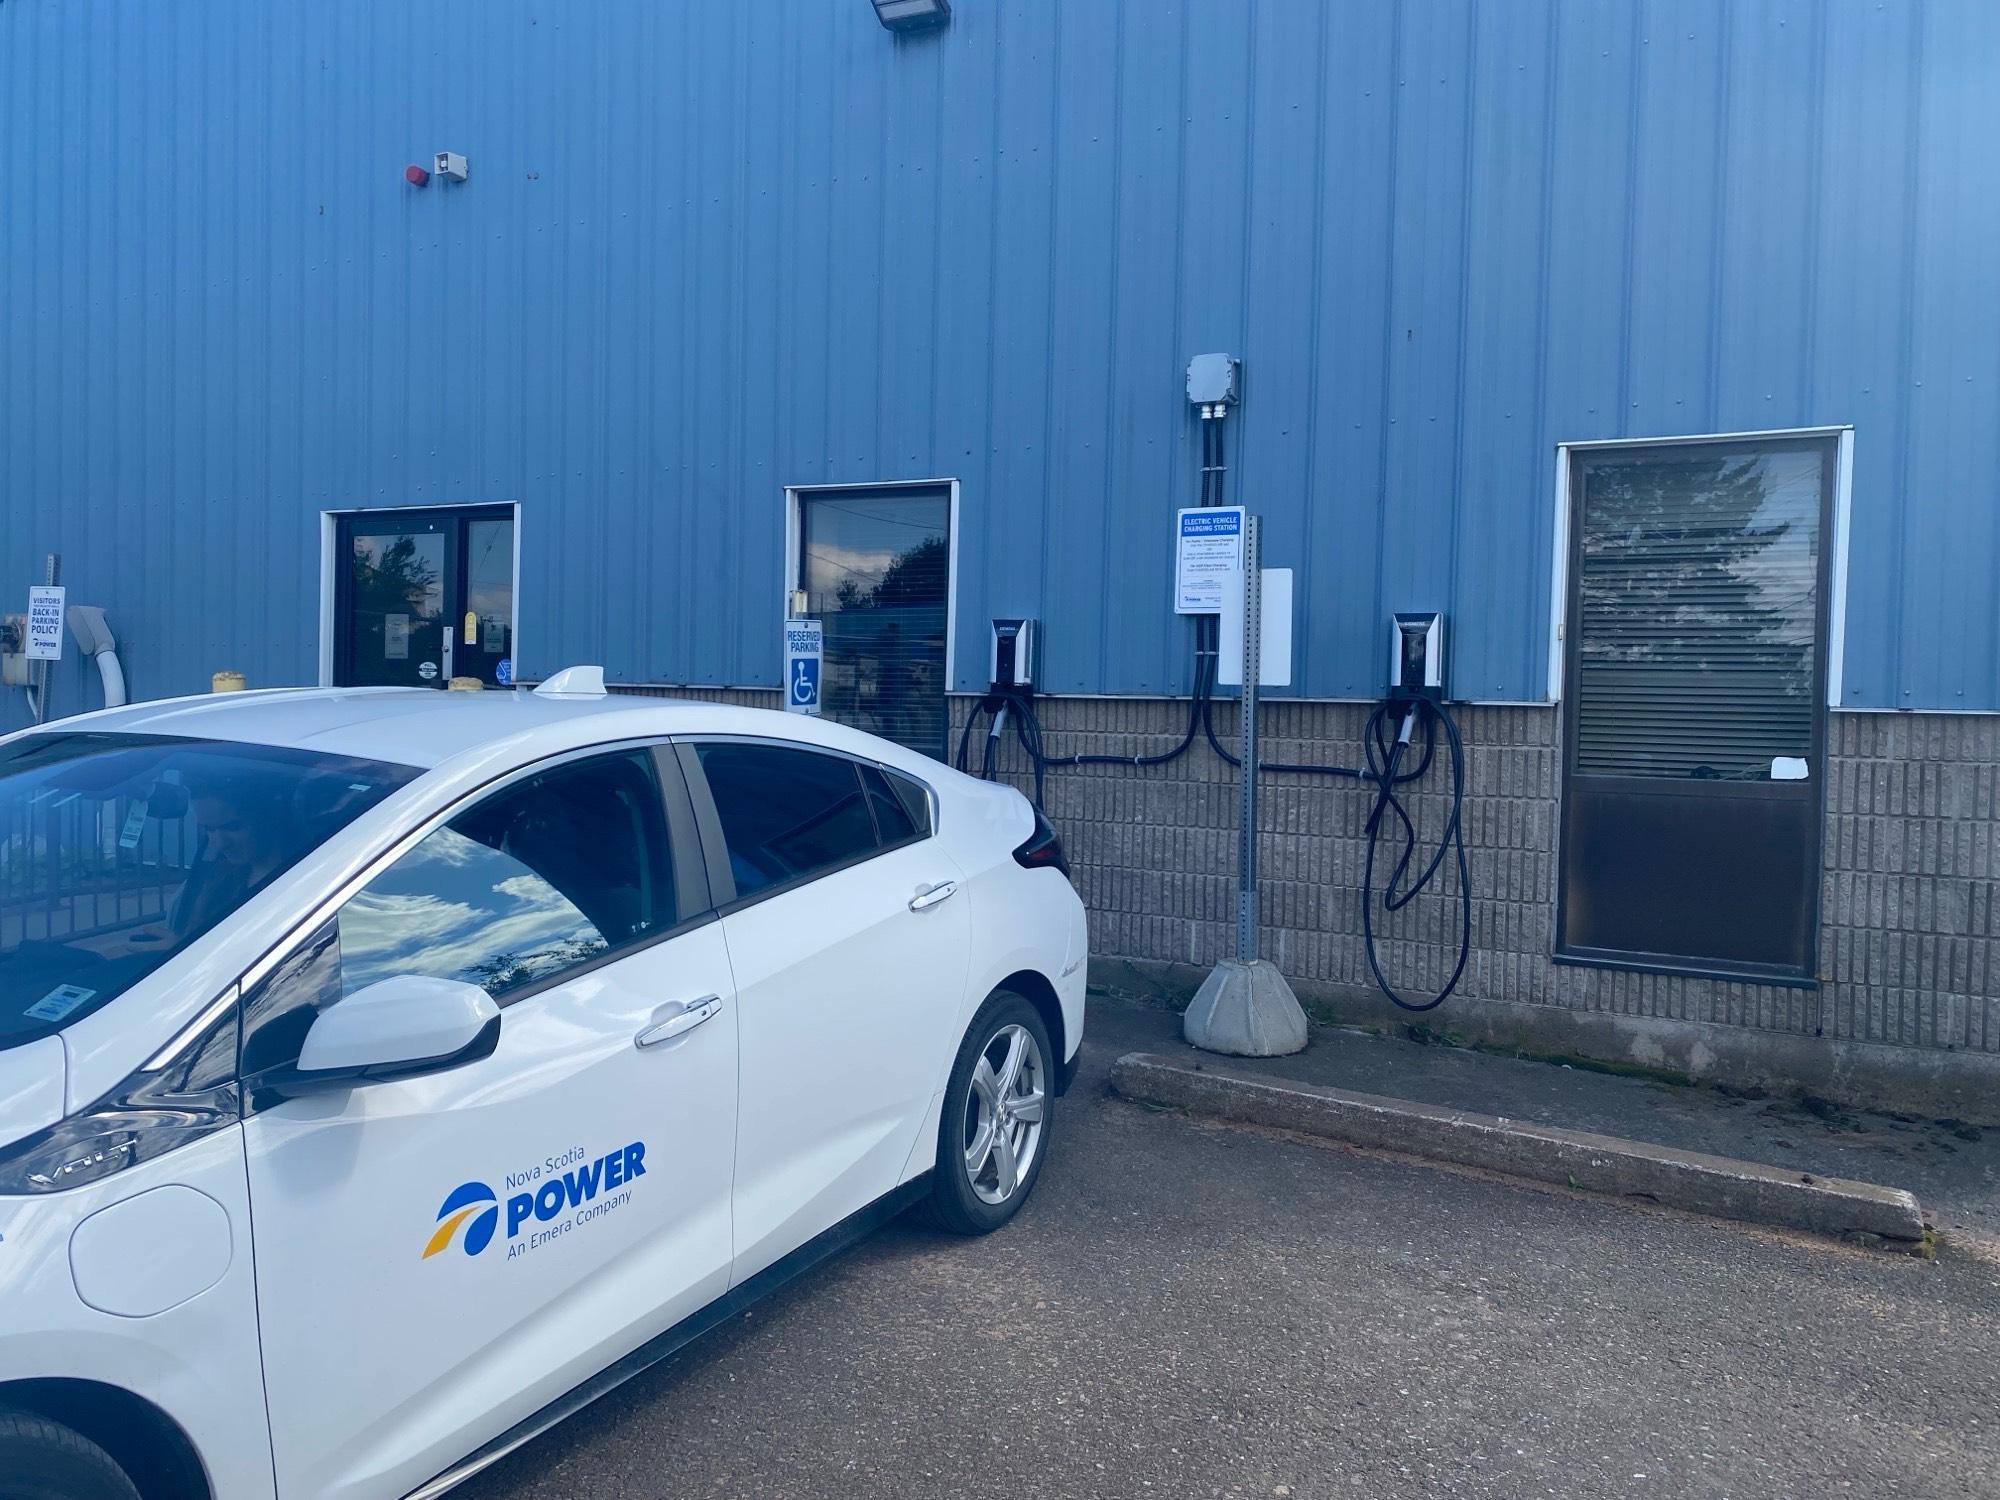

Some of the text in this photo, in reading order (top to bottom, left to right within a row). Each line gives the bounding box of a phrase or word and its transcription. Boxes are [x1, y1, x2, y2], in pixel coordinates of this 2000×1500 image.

[1213, 516, 1238, 524] VEHICLE
[32, 608, 60, 616] BACK-IN
[31, 617, 60, 625] PARKING
[31, 625, 59, 634] POLICY
[787, 630, 820, 641] RESERVED
[790, 641, 820, 652] PARKING
[506, 1146, 585, 1190] Nova Scotia
[507, 1141, 647, 1239] POWER
[507, 1189, 632, 1261] An Emera Company
